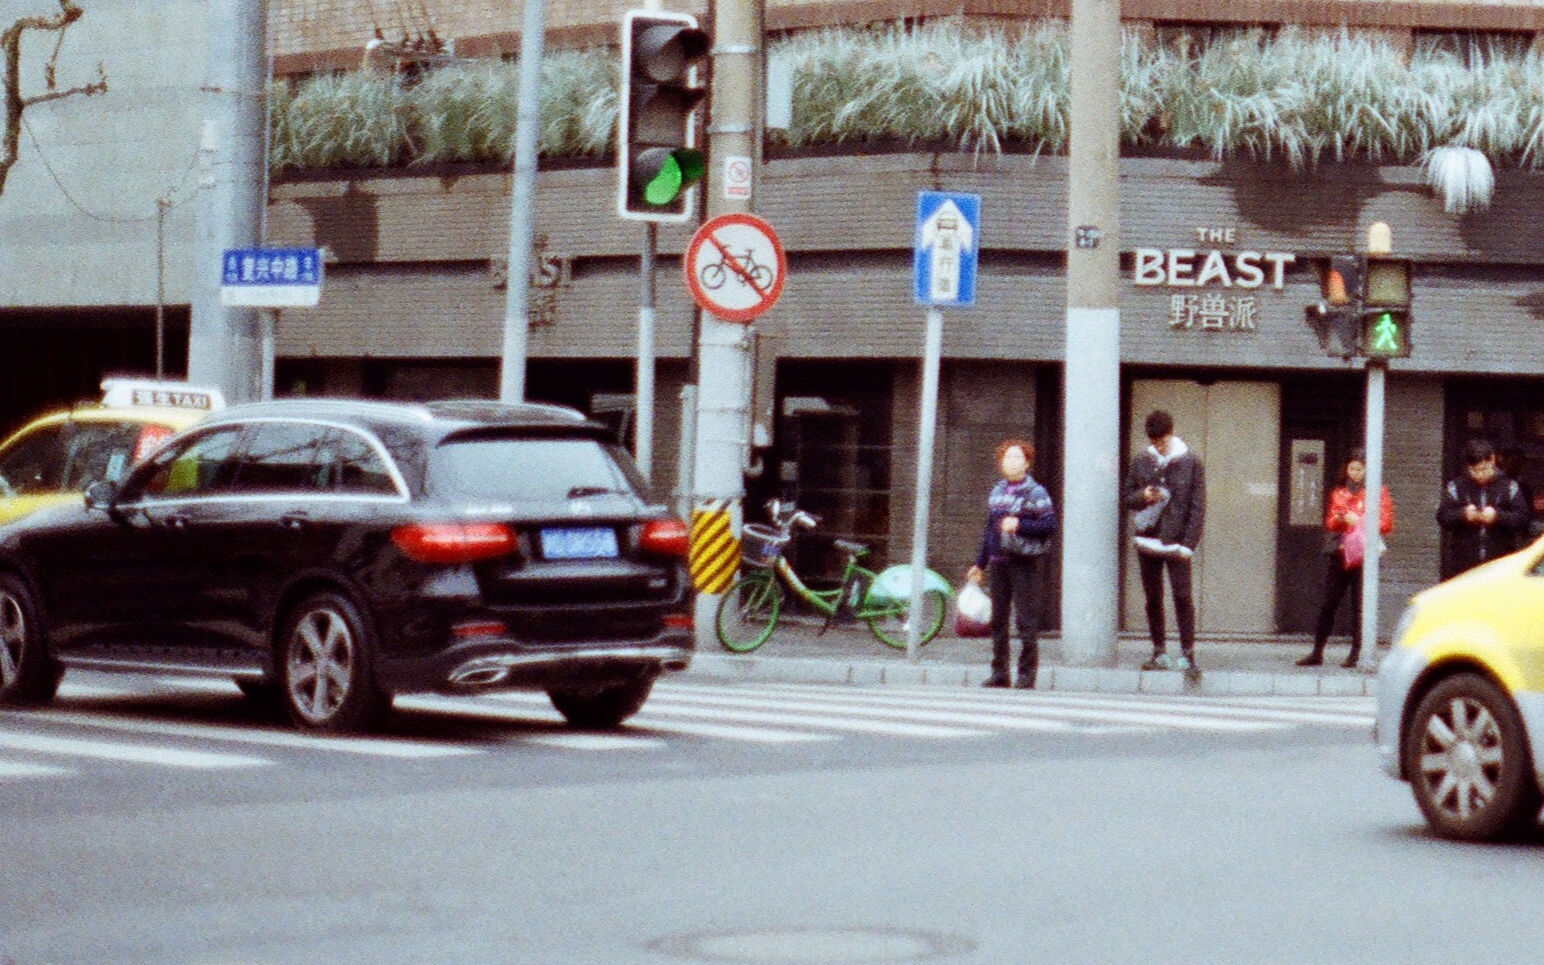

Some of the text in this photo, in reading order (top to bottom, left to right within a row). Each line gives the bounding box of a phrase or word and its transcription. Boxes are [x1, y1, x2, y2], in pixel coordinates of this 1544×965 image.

[1197, 227, 1236, 243] THE
[1135, 248, 1296, 289] BEAST
[1169, 292, 1257, 329] 野兽派
